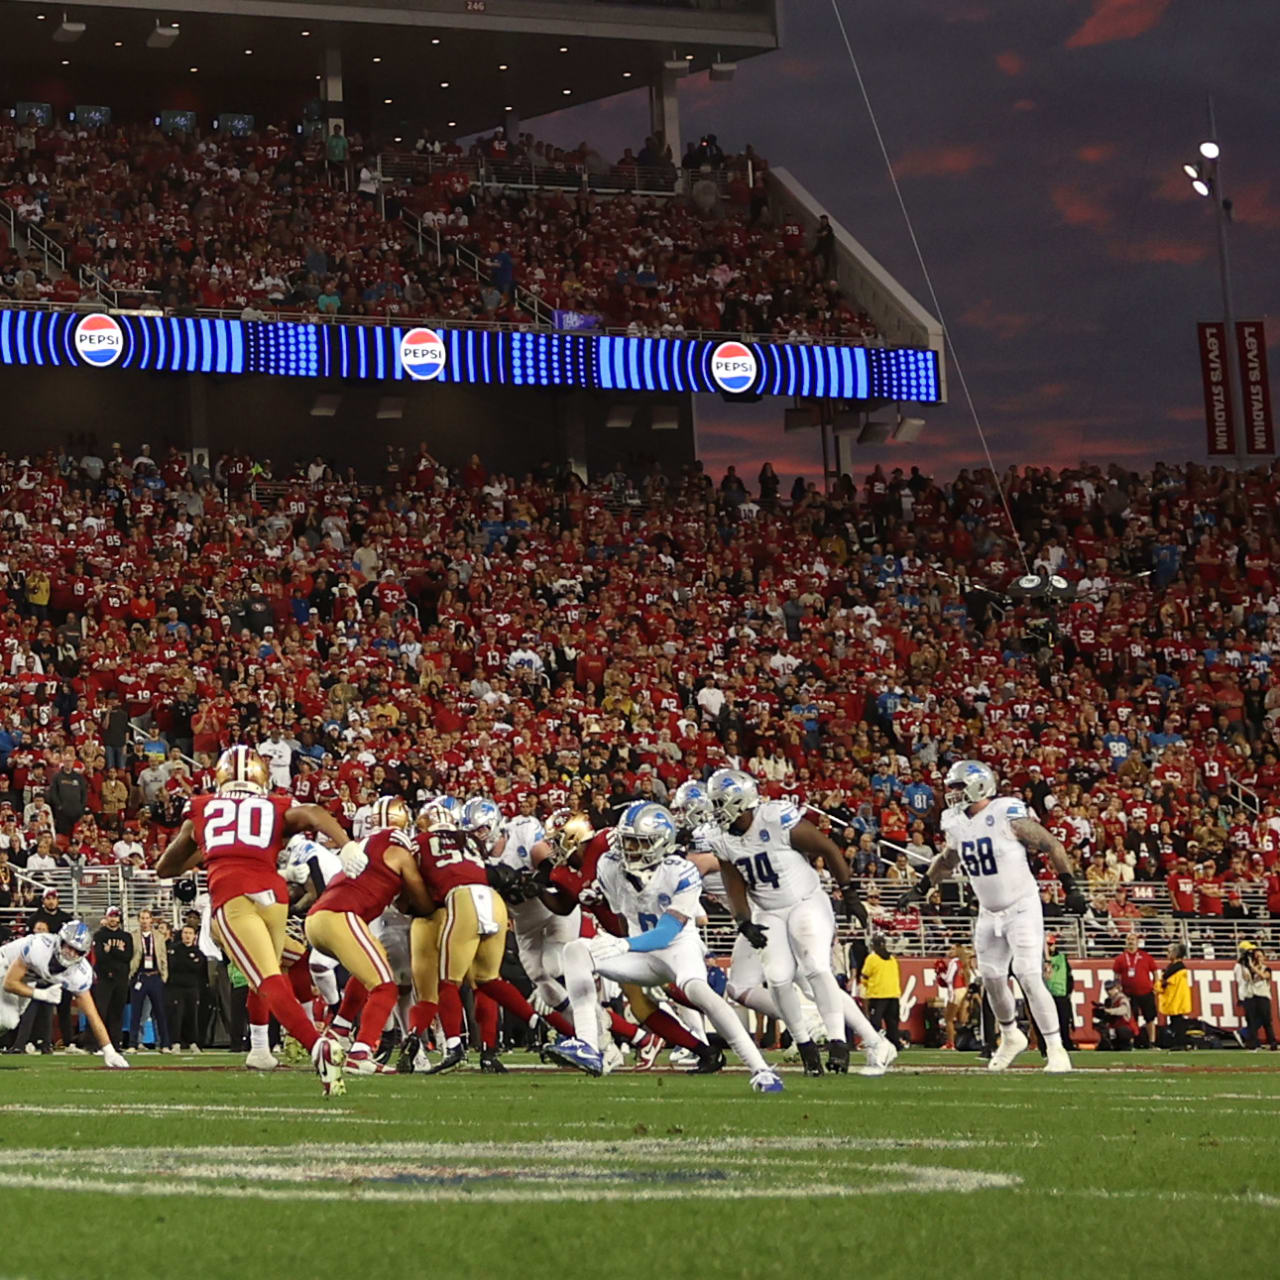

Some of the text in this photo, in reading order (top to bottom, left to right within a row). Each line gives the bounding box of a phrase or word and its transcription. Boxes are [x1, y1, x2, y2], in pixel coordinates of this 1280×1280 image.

[79, 333, 120, 346] PEPSI
[403, 348, 442, 360] PEPSI
[715, 361, 753, 373] PEPSI
[1211, 385, 1228, 450] STADIUM
[1250, 384, 1266, 450] STADIUM
[107, 535, 120, 546] 85
[1079, 631, 1095, 643] 52
[487, 652, 500, 664] 13
[1099, 650, 1112, 661] 21
[1014, 705, 1029, 718] 97
[1205, 762, 1218, 775] 13
[548, 790, 564, 802] 23
[914, 797, 927, 807] 81
[204, 800, 274, 850] 20
[961, 840, 998, 876] 68
[1134, 888, 1153, 896] 144
